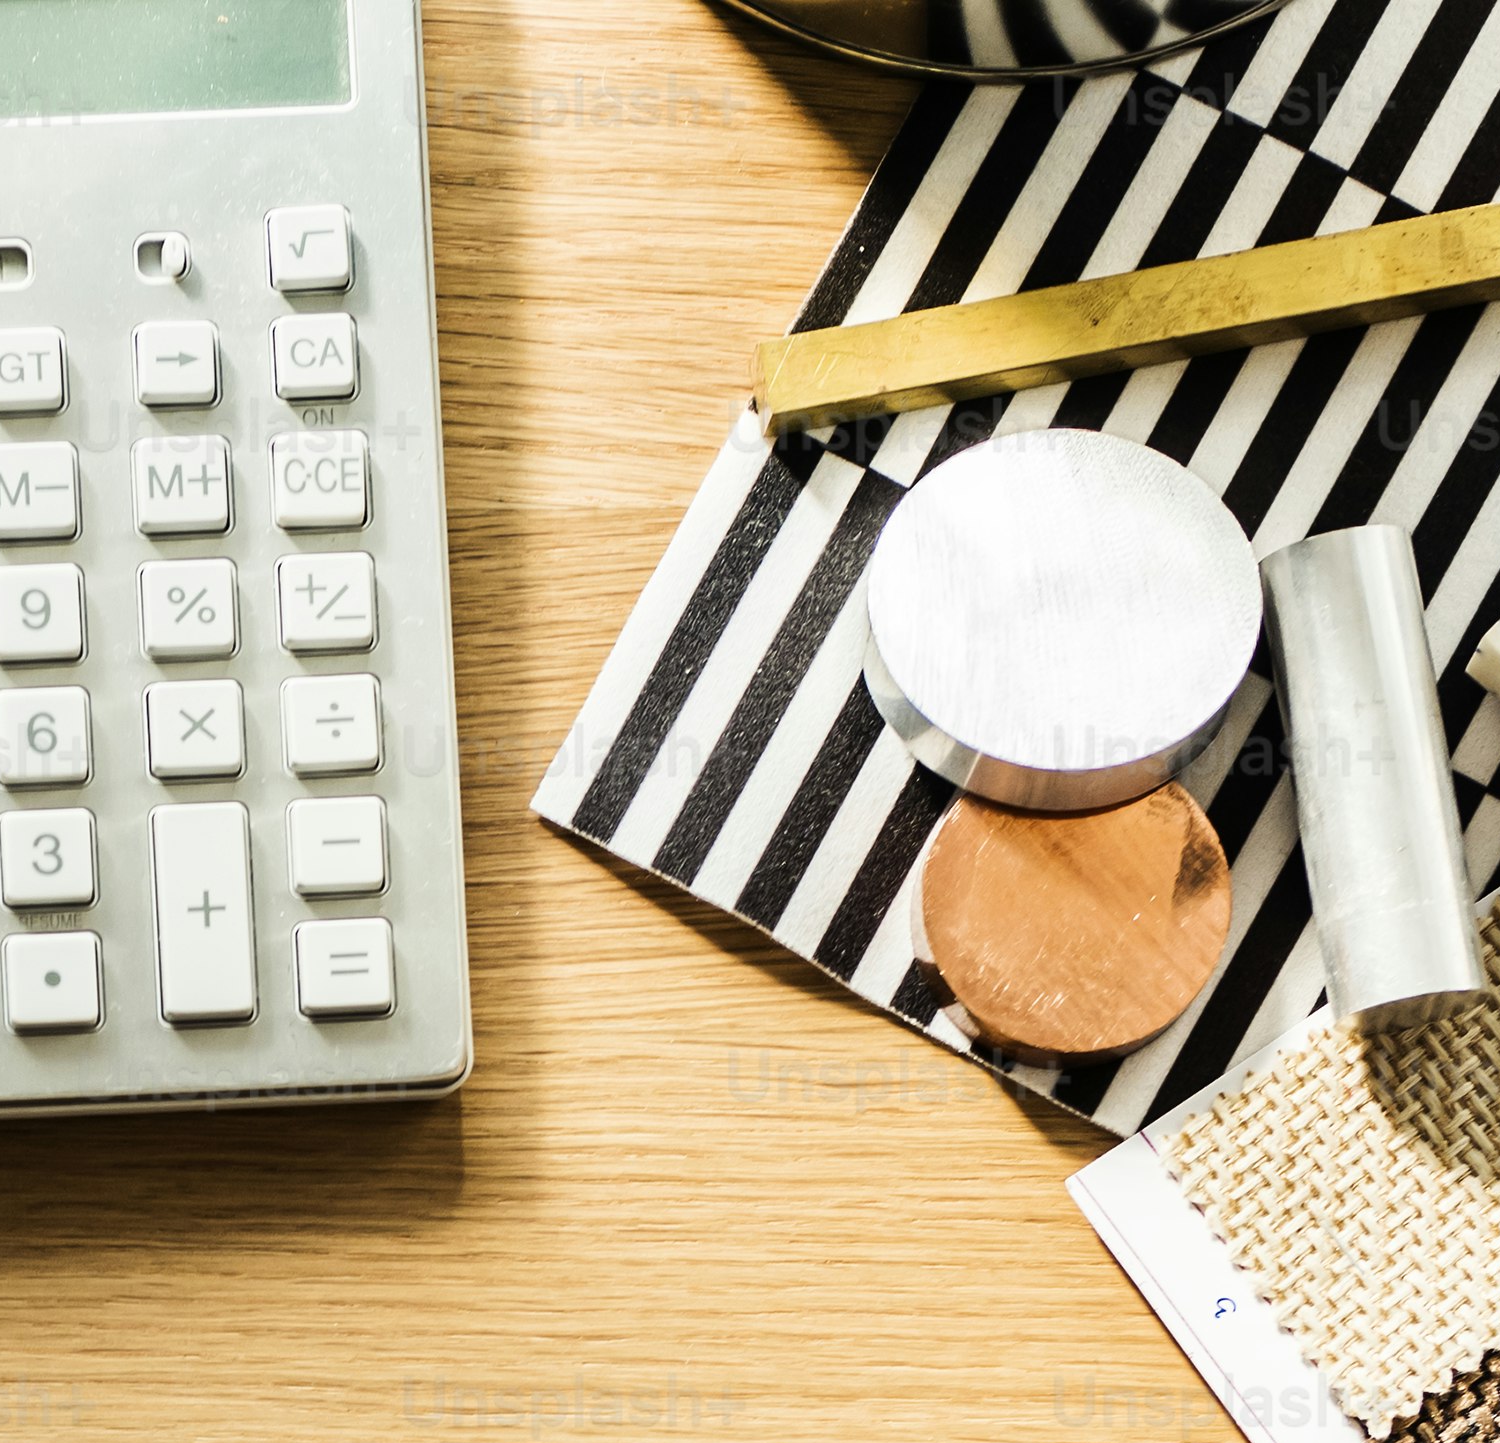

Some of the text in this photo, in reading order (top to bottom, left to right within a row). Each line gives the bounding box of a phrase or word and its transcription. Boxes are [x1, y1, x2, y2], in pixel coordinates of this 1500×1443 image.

[290, 338, 344, 369] CA
[302, 408, 334, 427] ON
[148, 464, 222, 499] M+
[20, 588, 52, 630] 9
[26, 712, 58, 755] 6
[31, 833, 63, 875] 3
